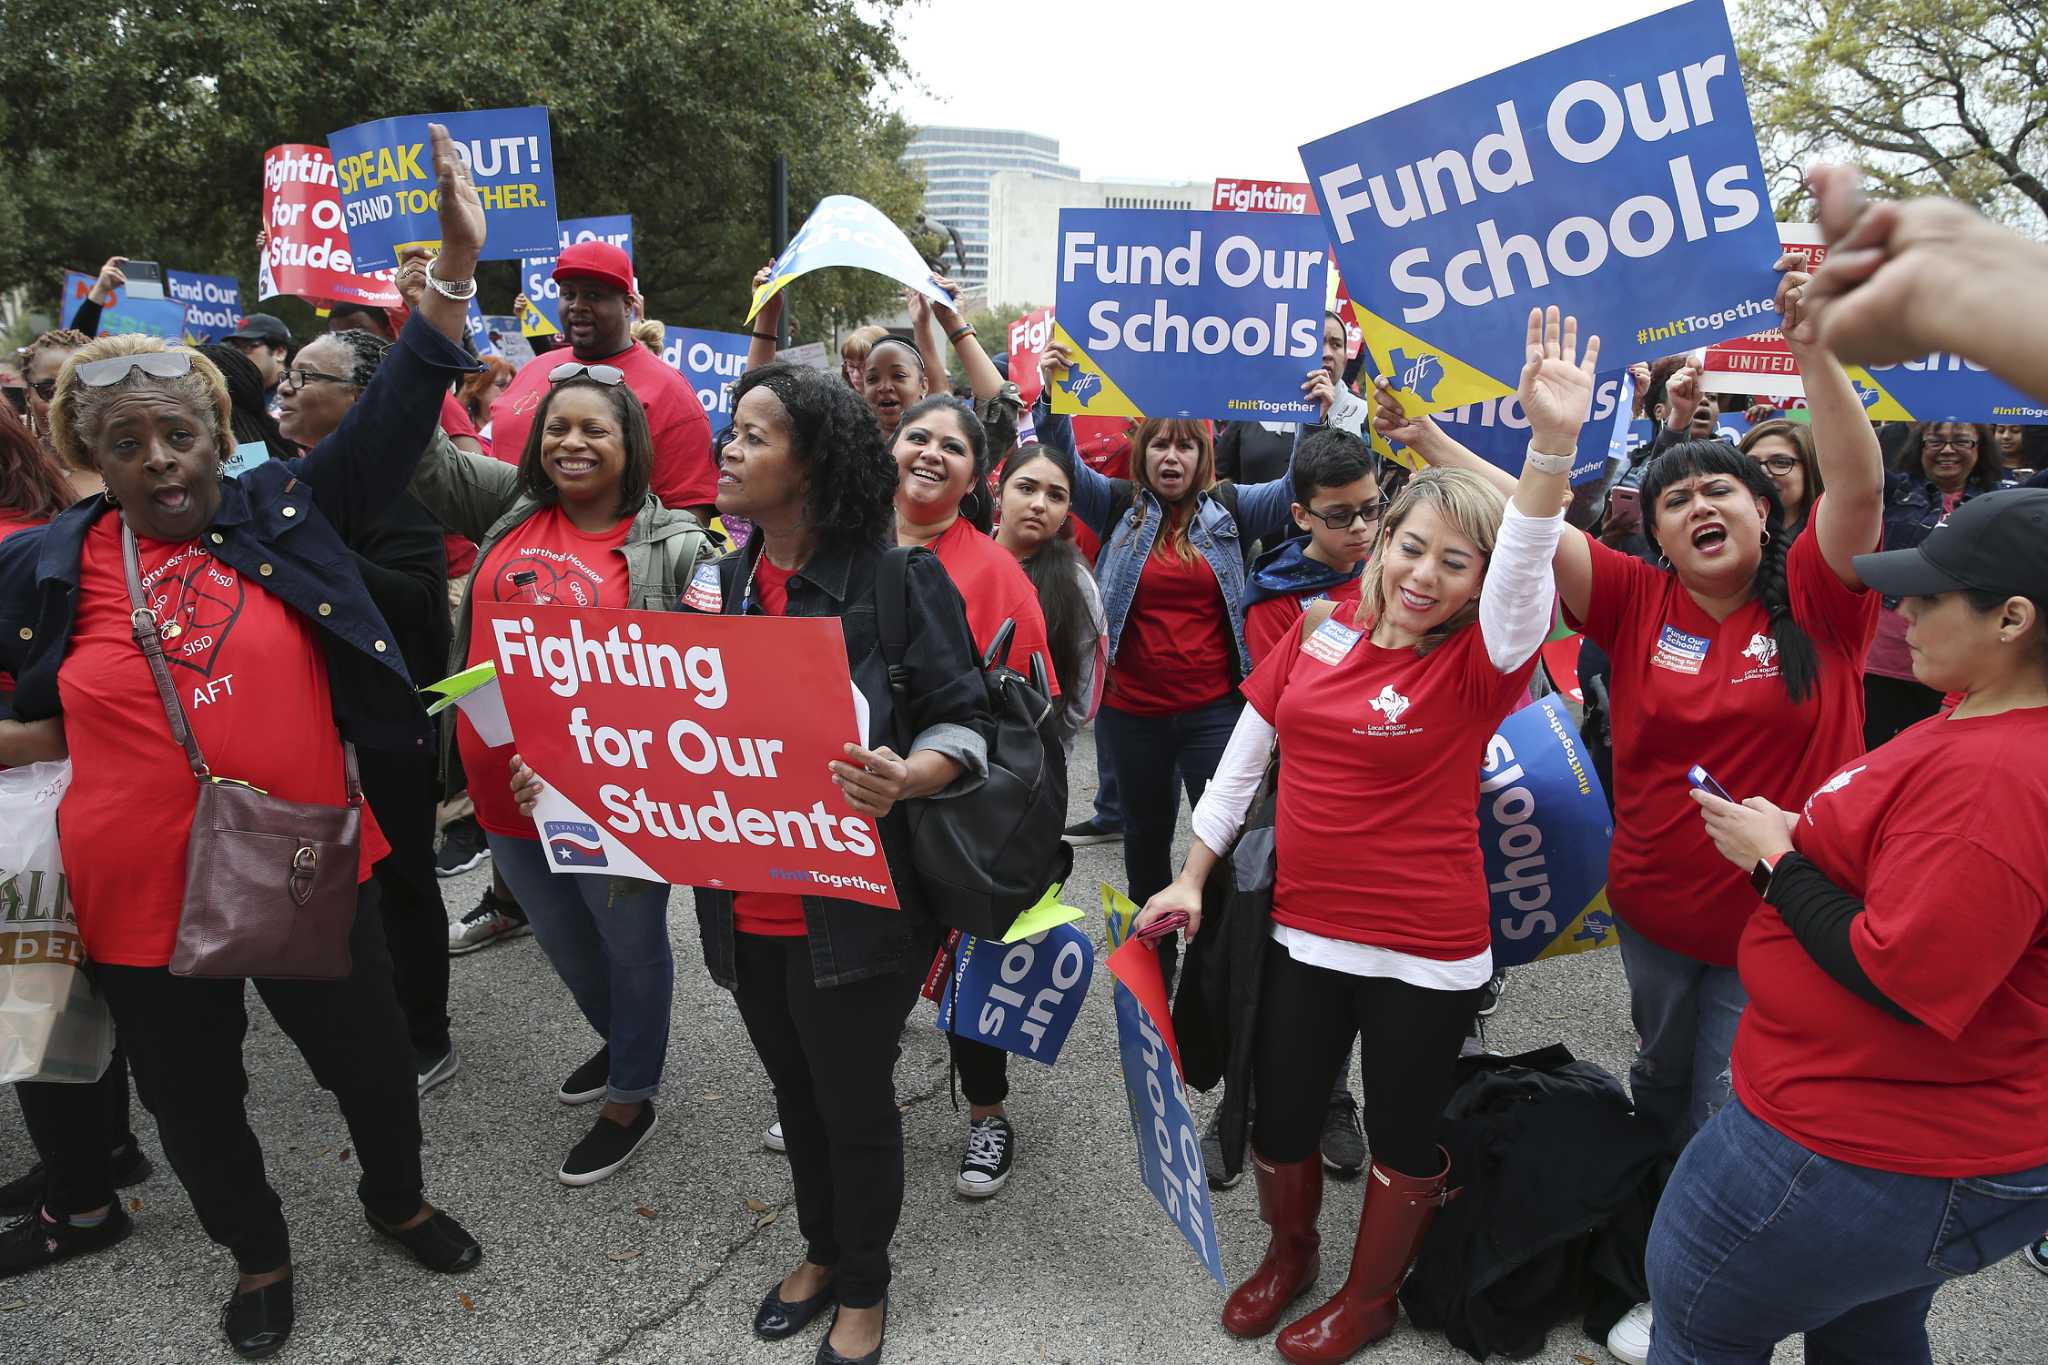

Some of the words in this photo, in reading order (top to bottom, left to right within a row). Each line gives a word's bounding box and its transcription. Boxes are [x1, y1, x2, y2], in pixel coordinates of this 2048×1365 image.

[337, 143, 427, 195] SPEAK
[1319, 100, 1534, 244] Fund
[1546, 55, 1726, 163] Our
[265, 151, 338, 192] Fightin
[272, 195, 306, 228] for
[346, 194, 393, 227] STAND
[396, 184, 547, 216] TOHER.
[1215, 183, 1307, 214] Fighting
[271, 236, 398, 282] Stude
[1063, 230, 1202, 286] Fund
[1215, 235, 1323, 289] Our
[1389, 154, 1760, 324] Schools
[168, 278, 203, 300] Fund
[204, 280, 238, 305] Our
[187, 306, 241, 329] chools
[1088, 299, 1318, 358] Schools
[1636, 298, 1775, 345] #InItTogethe
[1404, 353, 1439, 394] aft
[1728, 354, 1795, 372] UNITED
[1072, 373, 1101, 398] aft
[1228, 399, 1315, 413] #InItTogether
[570, 581, 588, 606] GPISD
[183, 635, 213, 656] SISD
[1666, 627, 1687, 642] Fund
[1688, 637, 1705, 646] Our
[1666, 634, 1700, 652] Schools
[491, 616, 728, 709] Fighting
[193, 673, 233, 709] AFT
[568, 707, 653, 769] for
[667, 719, 783, 778] Our
[1542, 703, 1592, 795] #InItTogether
[599, 783, 876, 857] Students
[1479, 733, 1557, 941] Schools
[1020, 941, 1083, 1053] Our
